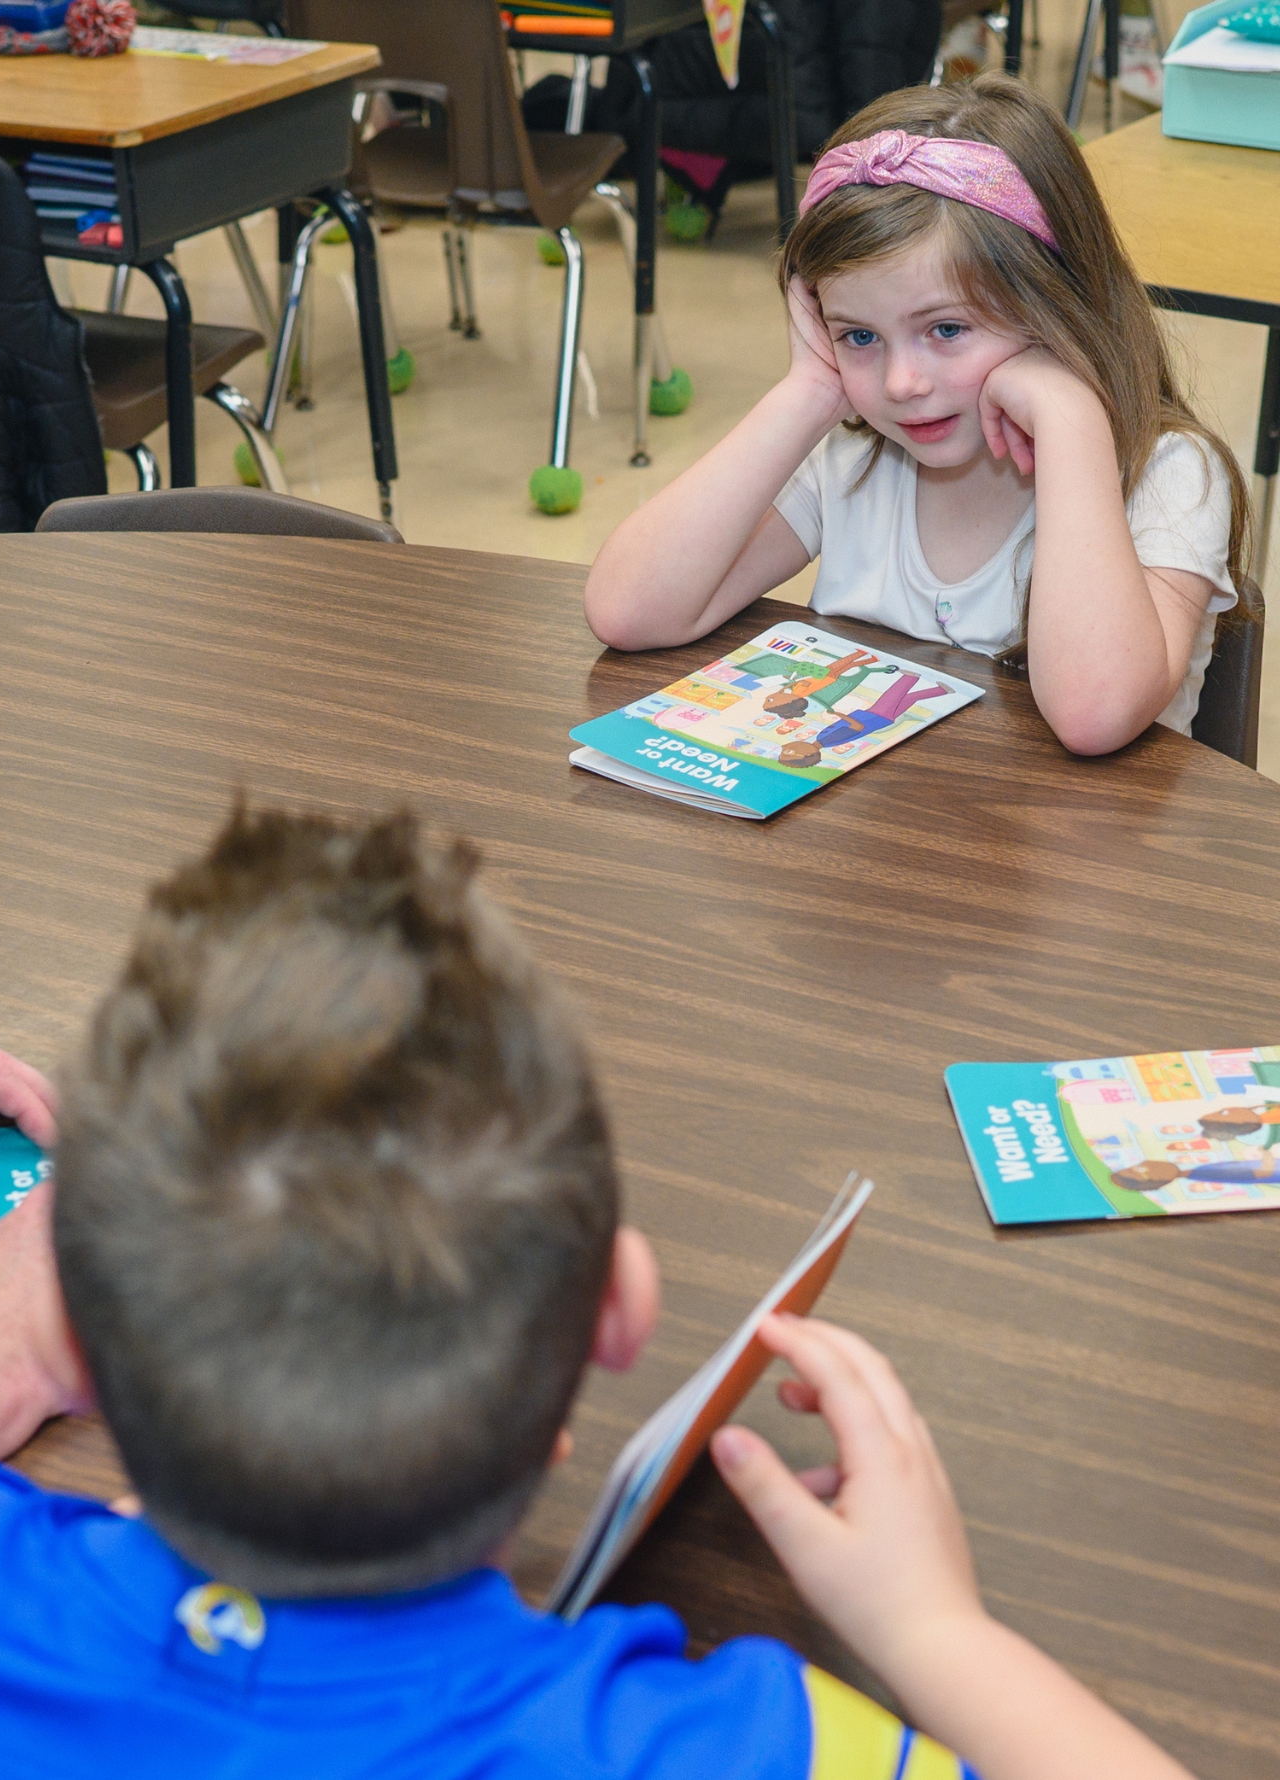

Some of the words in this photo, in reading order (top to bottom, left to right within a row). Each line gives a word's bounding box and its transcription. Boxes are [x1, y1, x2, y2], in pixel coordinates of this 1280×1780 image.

[635, 748, 663, 759] or
[644, 736, 740, 773] Need?
[658, 757, 739, 792] Want
[987, 1105, 1012, 1125] or
[1012, 1099, 1070, 1164] Need?
[983, 1125, 1035, 1183] Want
[10, 1169, 35, 1188] or
